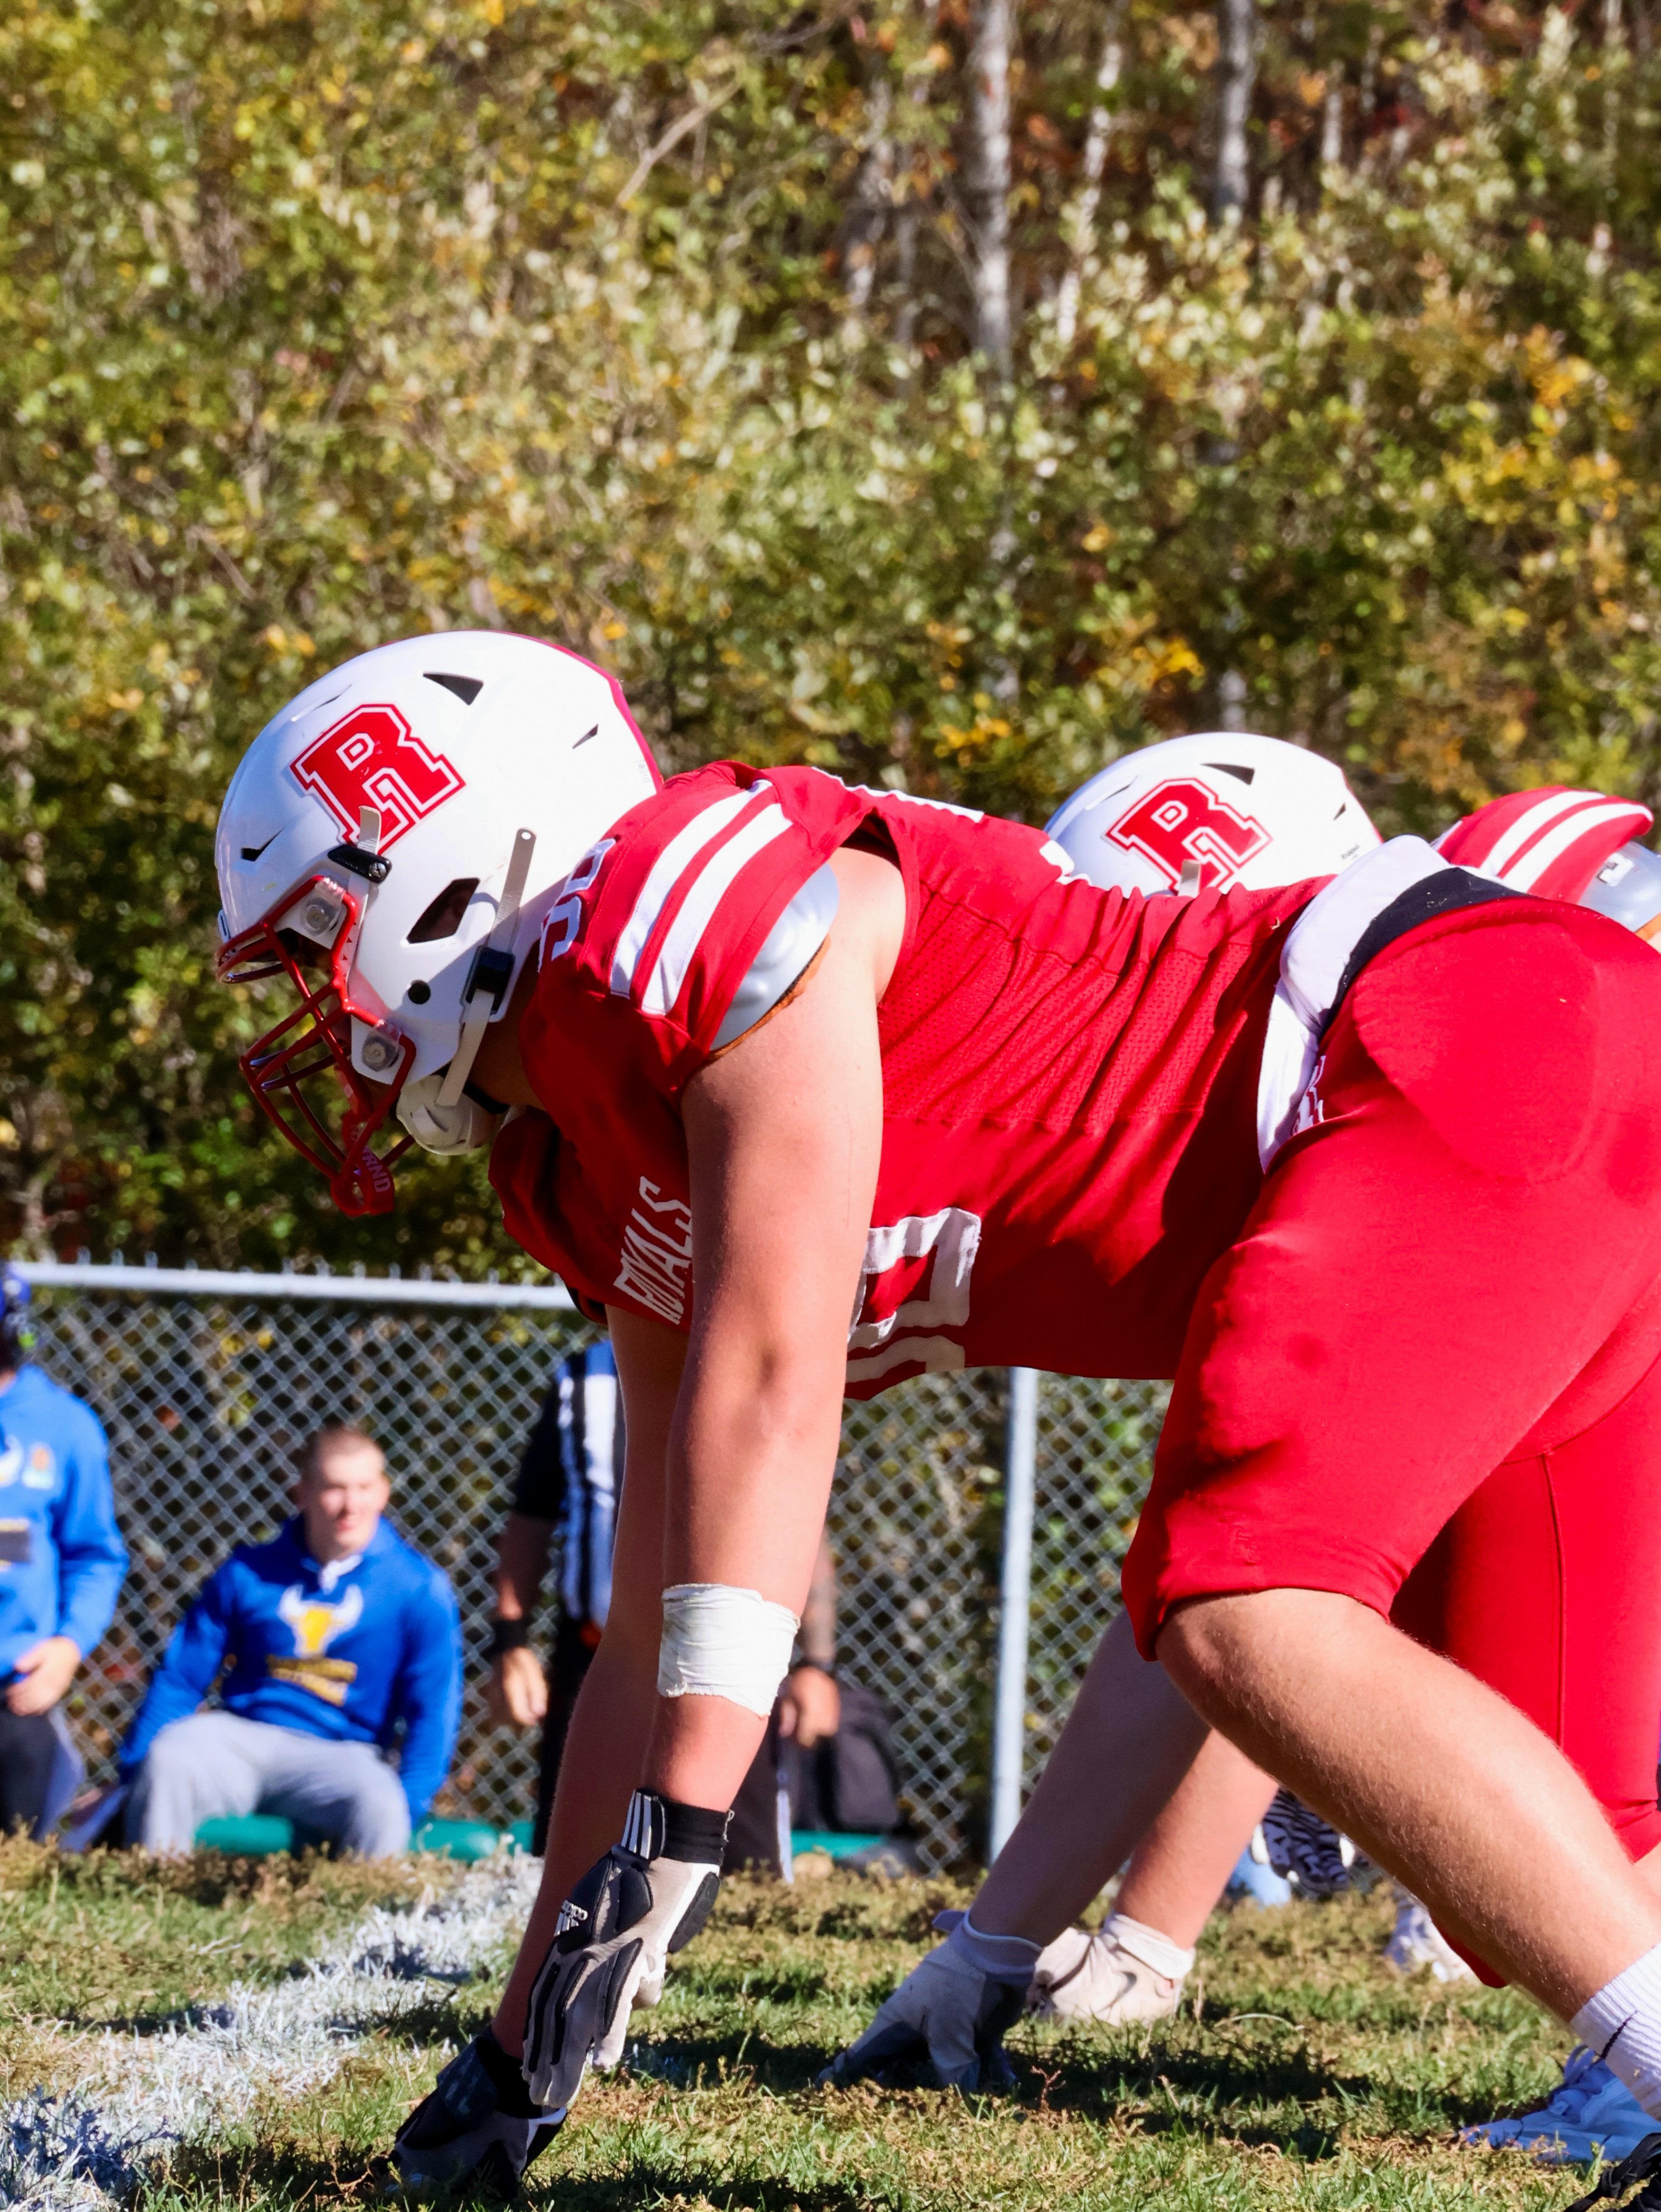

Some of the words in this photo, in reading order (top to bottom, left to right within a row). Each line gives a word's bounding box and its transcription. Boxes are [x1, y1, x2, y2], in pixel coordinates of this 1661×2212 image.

[289, 704, 467, 857] R
[1105, 778, 1274, 892] R
[613, 1175, 692, 1325] ROYALS
[561, 1899, 589, 1921] adidas
